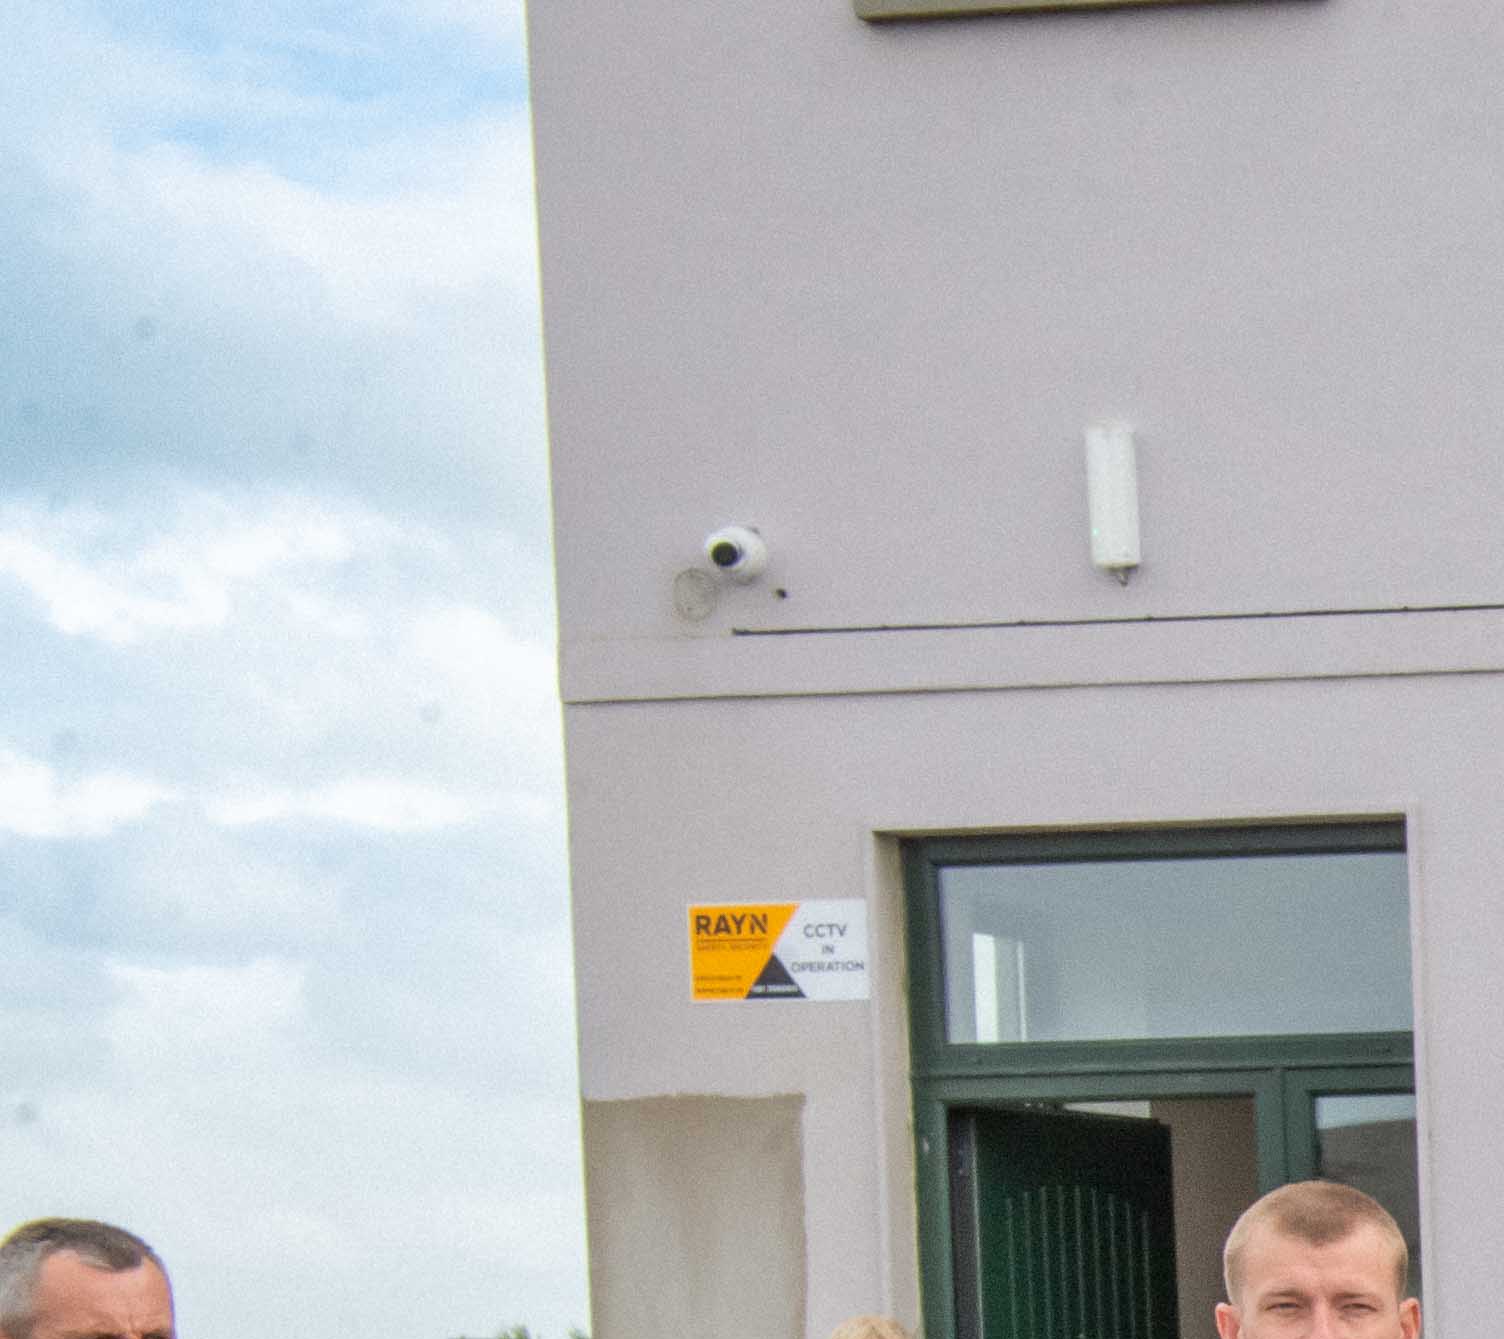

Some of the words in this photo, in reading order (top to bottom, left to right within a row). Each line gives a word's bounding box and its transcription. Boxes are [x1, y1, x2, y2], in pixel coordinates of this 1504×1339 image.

[695, 914, 768, 935] RAYN
[802, 923, 848, 938] CCTV
[822, 945, 835, 955] IN
[790, 960, 865, 973] OPERATION
